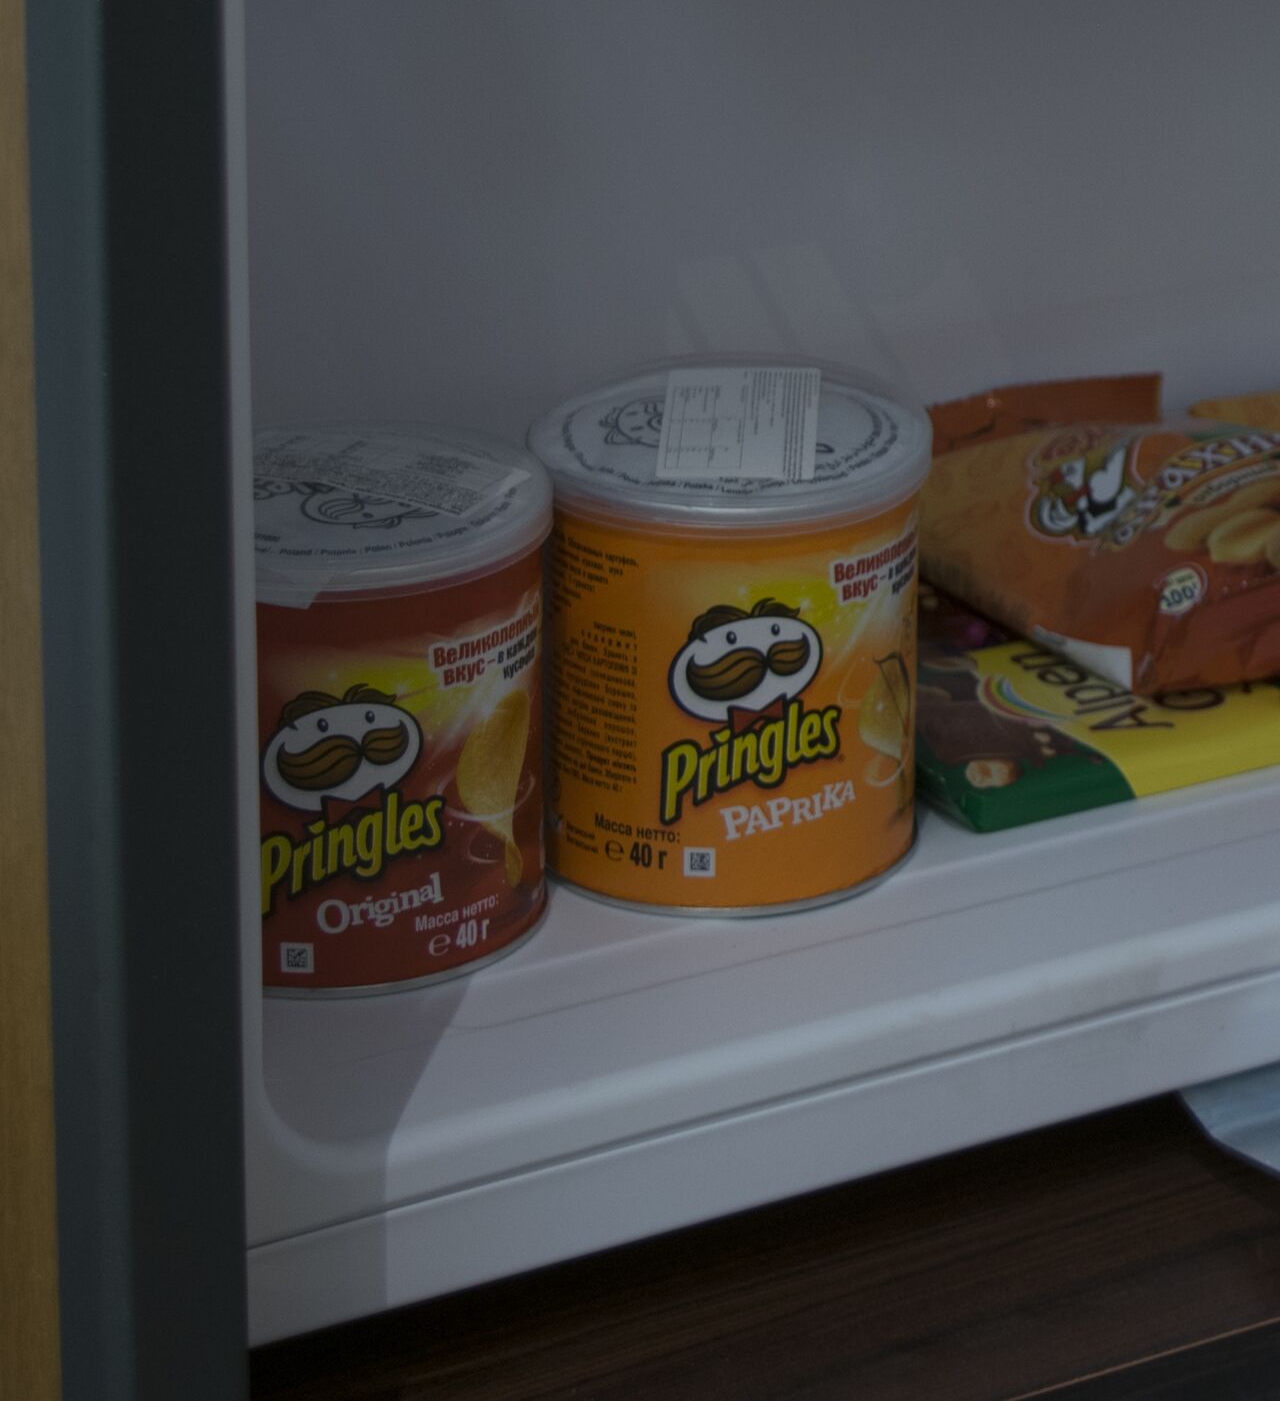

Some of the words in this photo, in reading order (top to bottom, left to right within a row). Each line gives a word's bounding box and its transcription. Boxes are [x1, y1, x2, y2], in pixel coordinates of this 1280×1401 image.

[842, 573, 879, 602] вкус
[442, 658, 485, 687] вкус
[664, 701, 838, 822] Pringles
[594, 812, 633, 837] Масса
[636, 825, 681, 844] нетто:
[719, 779, 857, 841] PAPRIKA
[262, 792, 443, 915] Pringles
[629, 842, 653, 868] 40
[657, 849, 668, 870] г
[316, 871, 445, 935] Original
[414, 912, 459, 933] Масса
[462, 893, 500, 920] нетто:
[455, 920, 477, 949] 40
[480, 918, 491, 941] г
